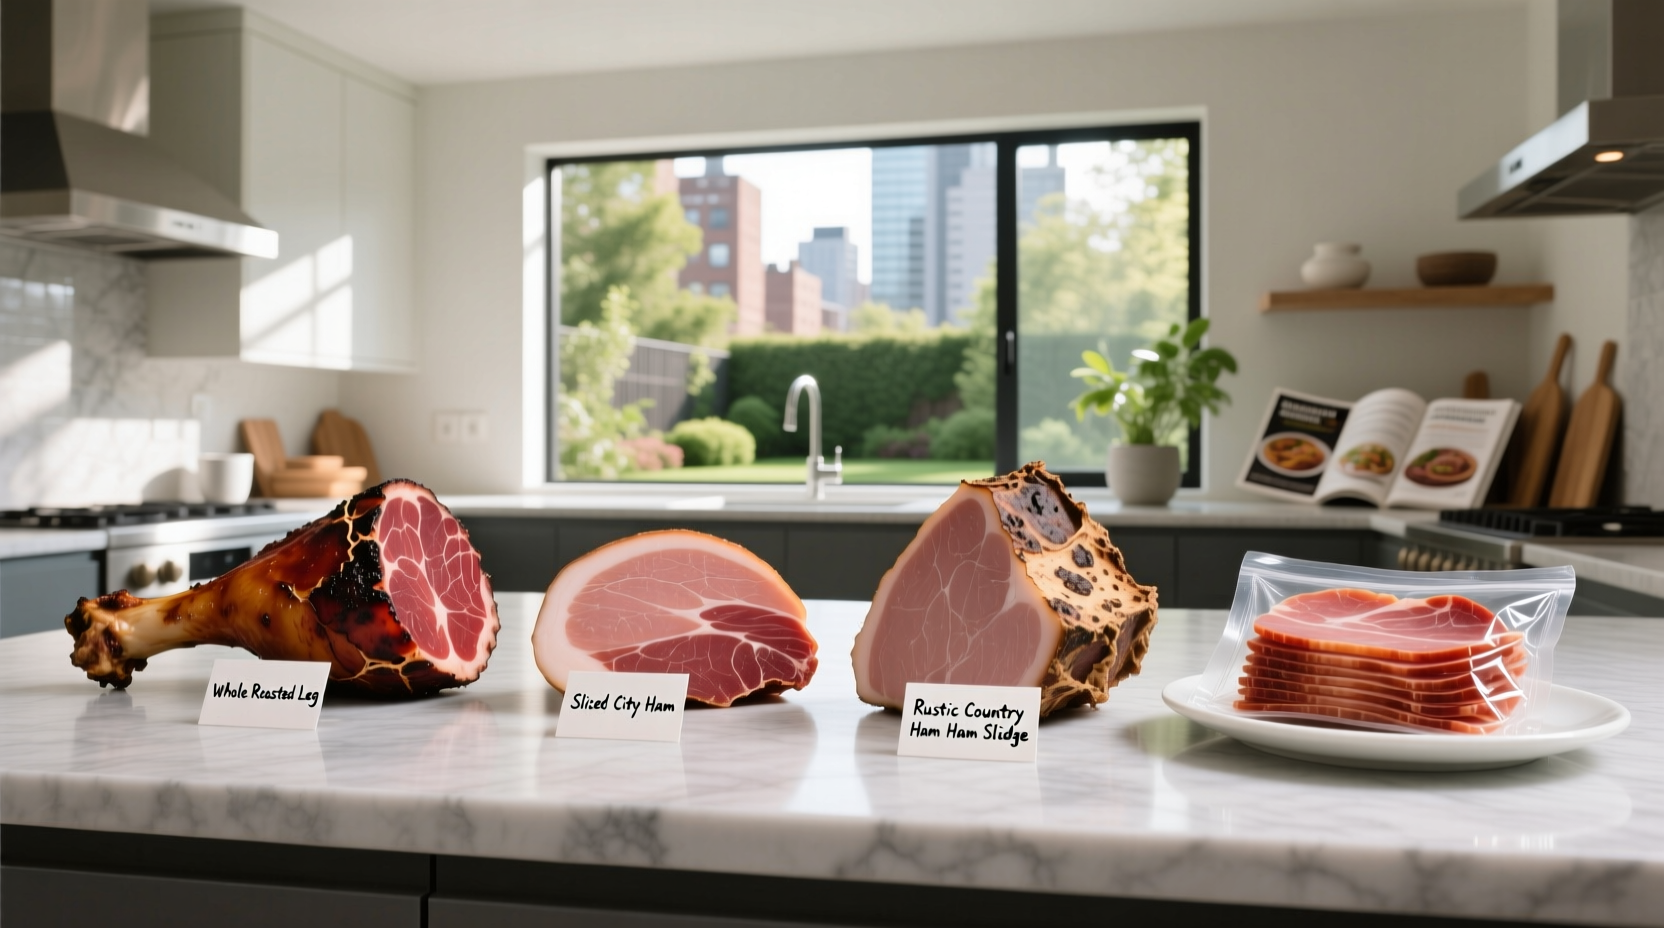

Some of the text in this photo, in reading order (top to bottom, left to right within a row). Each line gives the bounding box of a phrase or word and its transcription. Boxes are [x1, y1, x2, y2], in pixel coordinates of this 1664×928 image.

[213, 681, 248, 699] Whole
[297, 684, 320, 708] Leg
[613, 694, 641, 719] City
[644, 695, 675, 713] Ham
[913, 698, 1025, 727] Rustic Country
[909, 721, 1029, 748] Ham Ham Slidge
